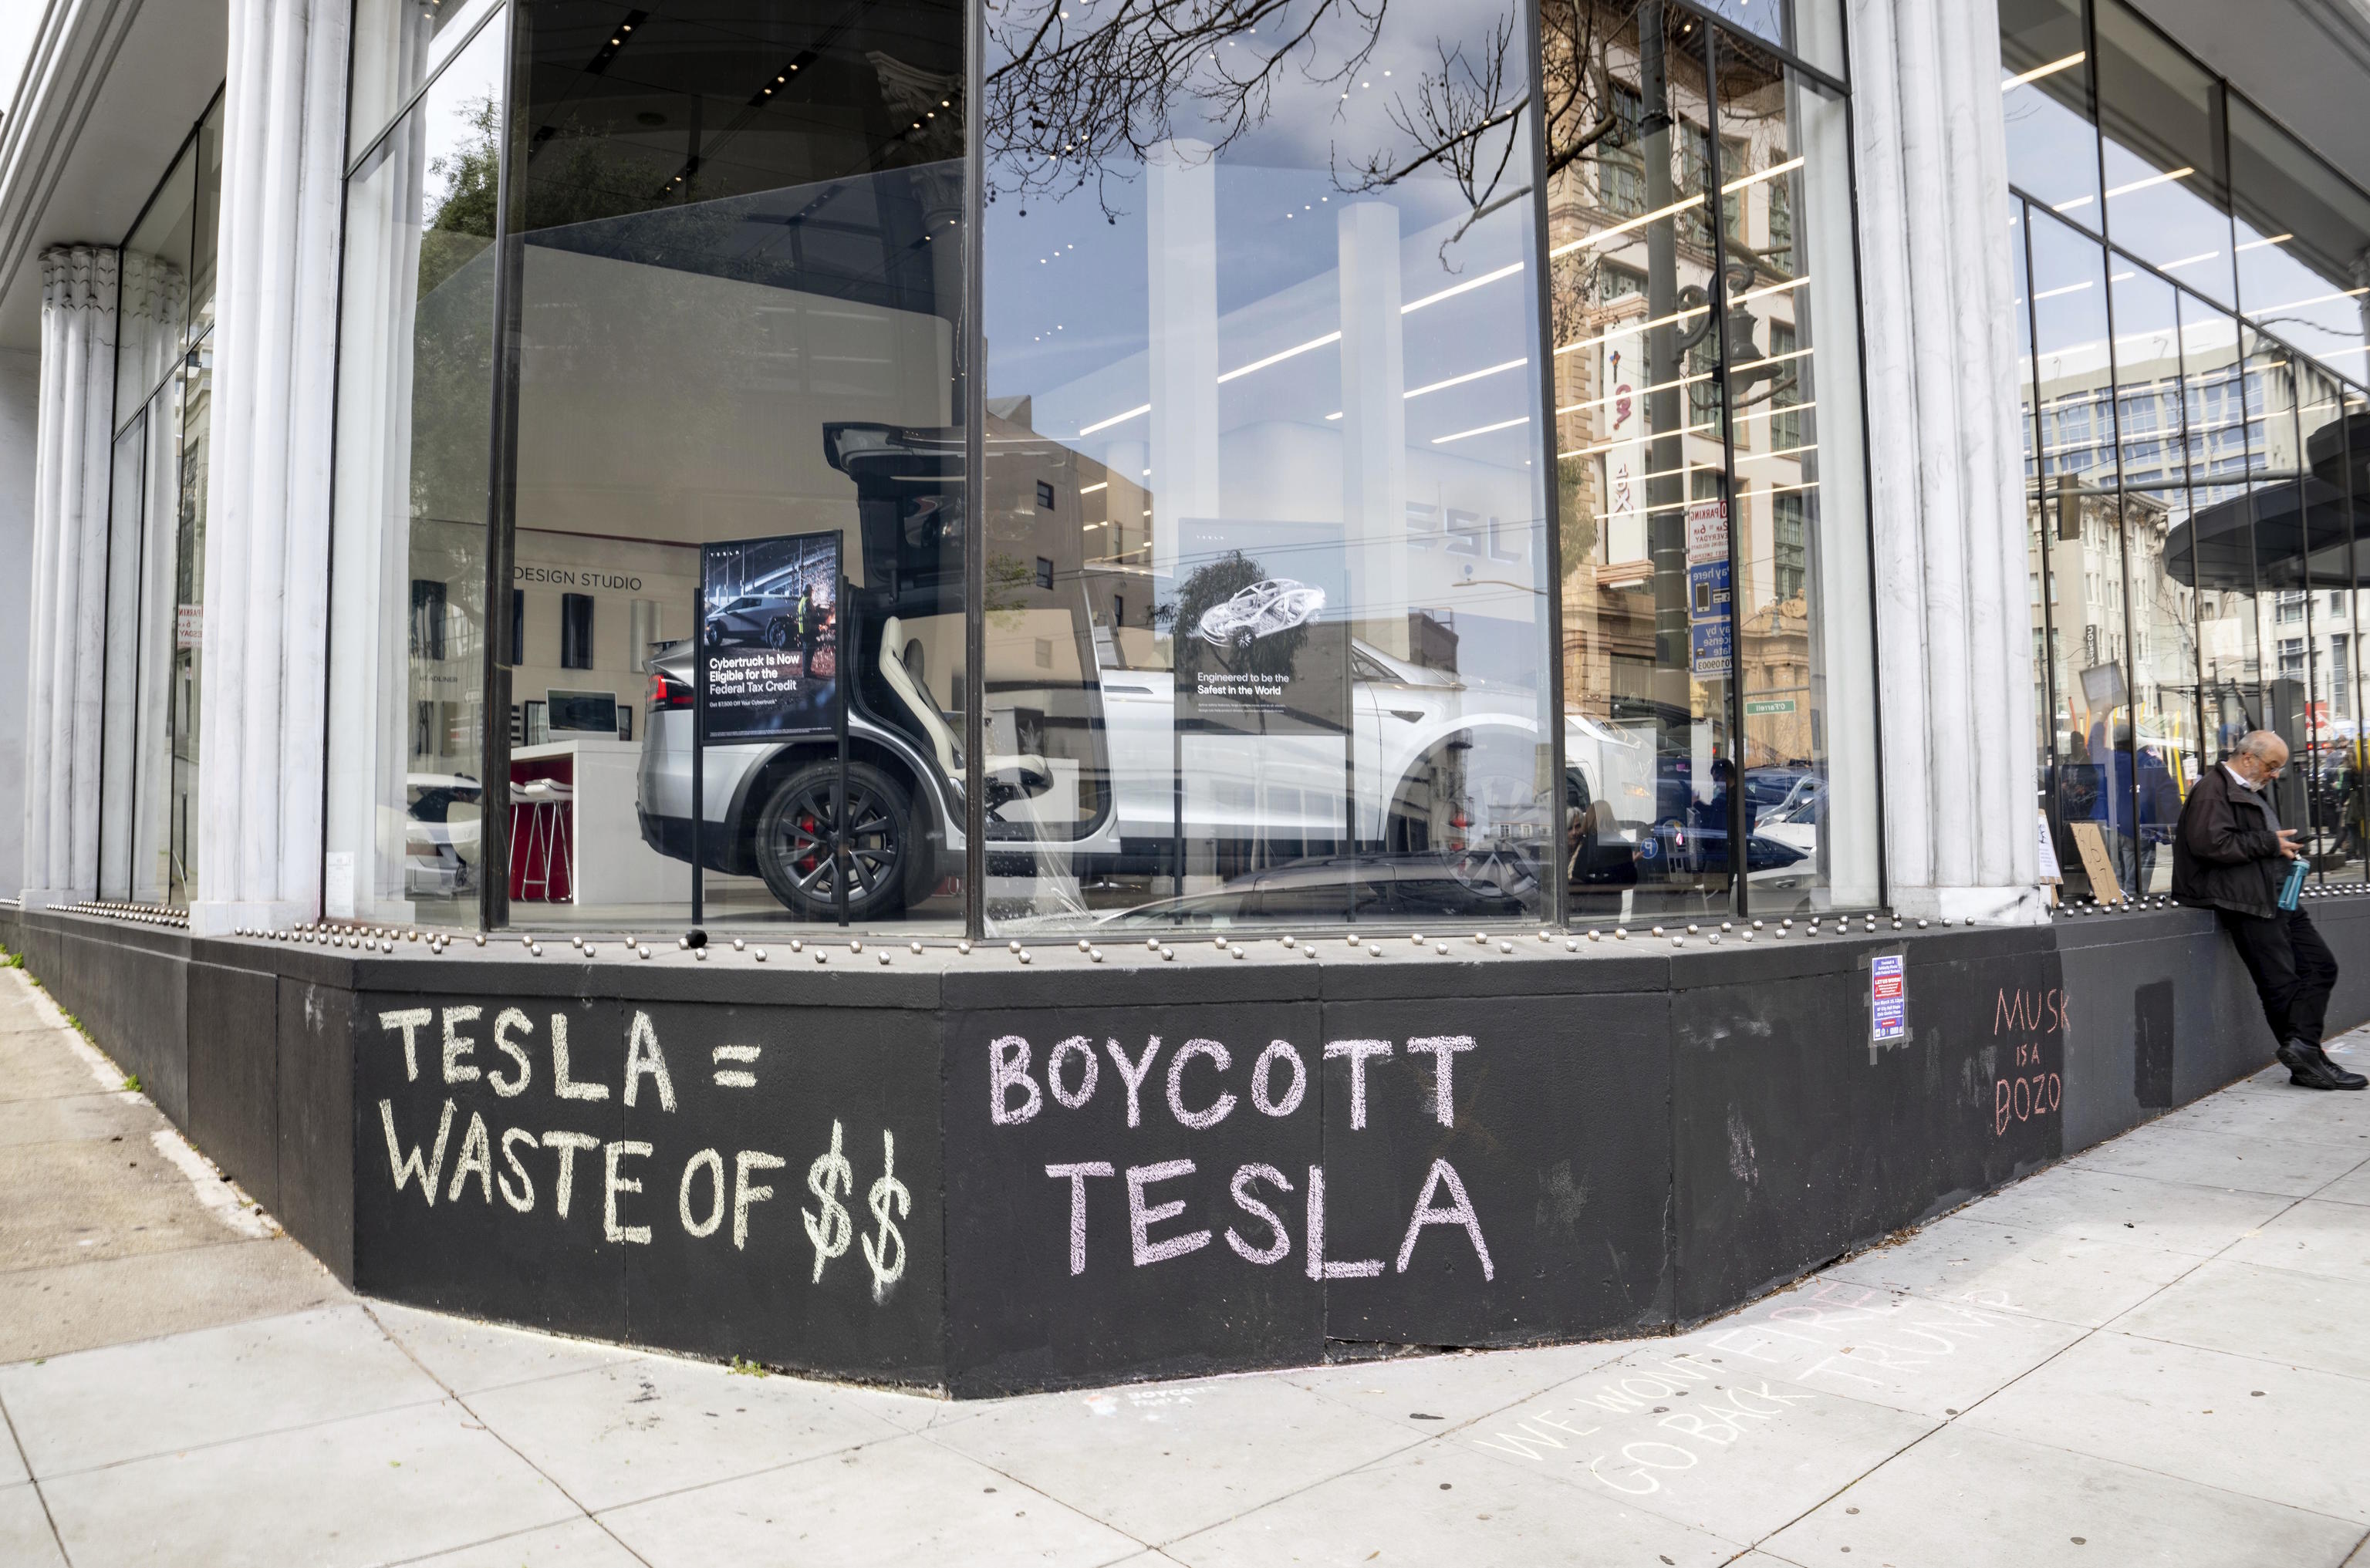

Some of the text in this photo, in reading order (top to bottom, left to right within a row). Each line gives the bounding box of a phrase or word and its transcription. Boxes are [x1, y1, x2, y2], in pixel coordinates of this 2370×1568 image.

[514, 567, 642, 591] DESIGN STUDIO
[709, 652, 800, 671] Cybertruck Is Now
[709, 667, 778, 683] Eligible for the
[1197, 672, 1290, 684] Engineered to be the
[709, 679, 797, 695] Federal Tax Credit
[1197, 684, 1281, 695] Safest in the World
[1994, 987, 2071, 1036] MUSK
[378, 1005, 677, 1112] TESLA
[2017, 1043, 2041, 1067] IS A
[989, 1035, 1477, 1130] BOYCOTT
[1996, 1073, 2061, 1136] BOZO
[378, 1098, 911, 1306] WASTE OF $$
[1045, 1158, 1494, 1281] TESLA
[1796, 1288, 2037, 1386] TRUMP
[1473, 1410, 1602, 1462] WE
[1590, 1381, 1816, 1495] GO BACK
